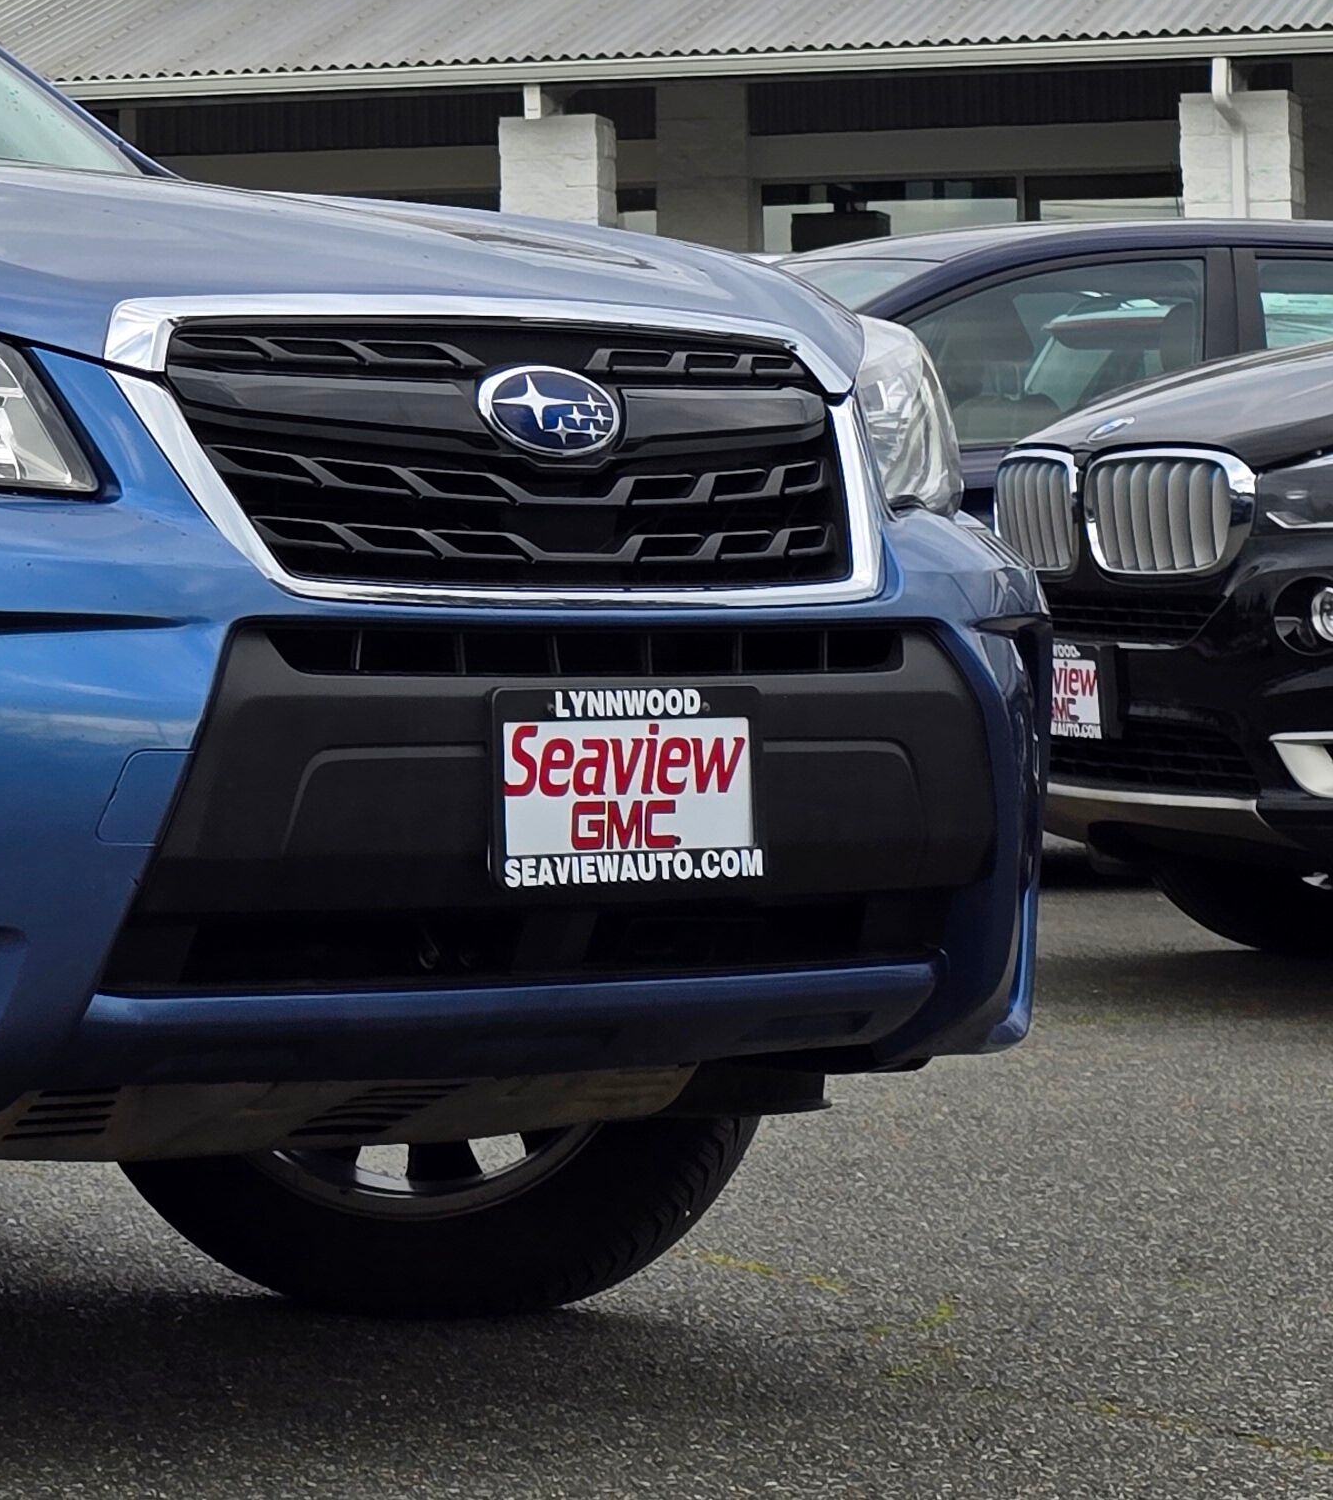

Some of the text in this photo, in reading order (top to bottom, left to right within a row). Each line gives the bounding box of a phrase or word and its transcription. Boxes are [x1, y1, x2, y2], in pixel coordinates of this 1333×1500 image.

[554, 689, 701, 717] LYNNWOOD
[1052, 698, 1077, 721] MC
[504, 723, 746, 797] Seaview
[571, 800, 677, 850] GMC
[504, 849, 763, 888] SEAVIEWAUTO.COM
